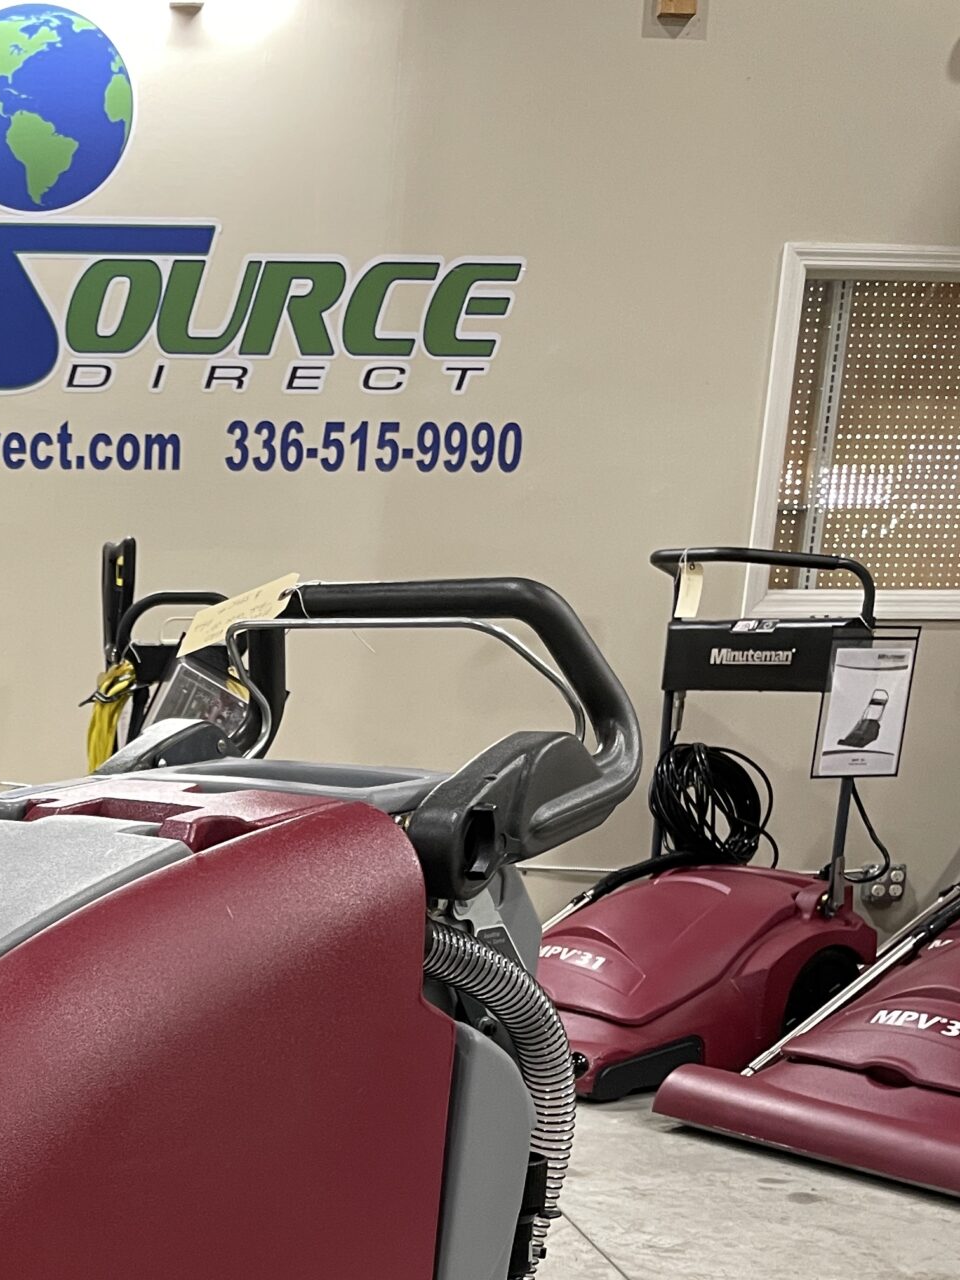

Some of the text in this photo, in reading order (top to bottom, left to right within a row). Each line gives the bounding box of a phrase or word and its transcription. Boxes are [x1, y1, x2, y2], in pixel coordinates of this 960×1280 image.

[65, 363, 486, 392] DIRECT
[224, 419, 523, 474] 336-515-9990
[709, 647, 793, 666] Minuteman
